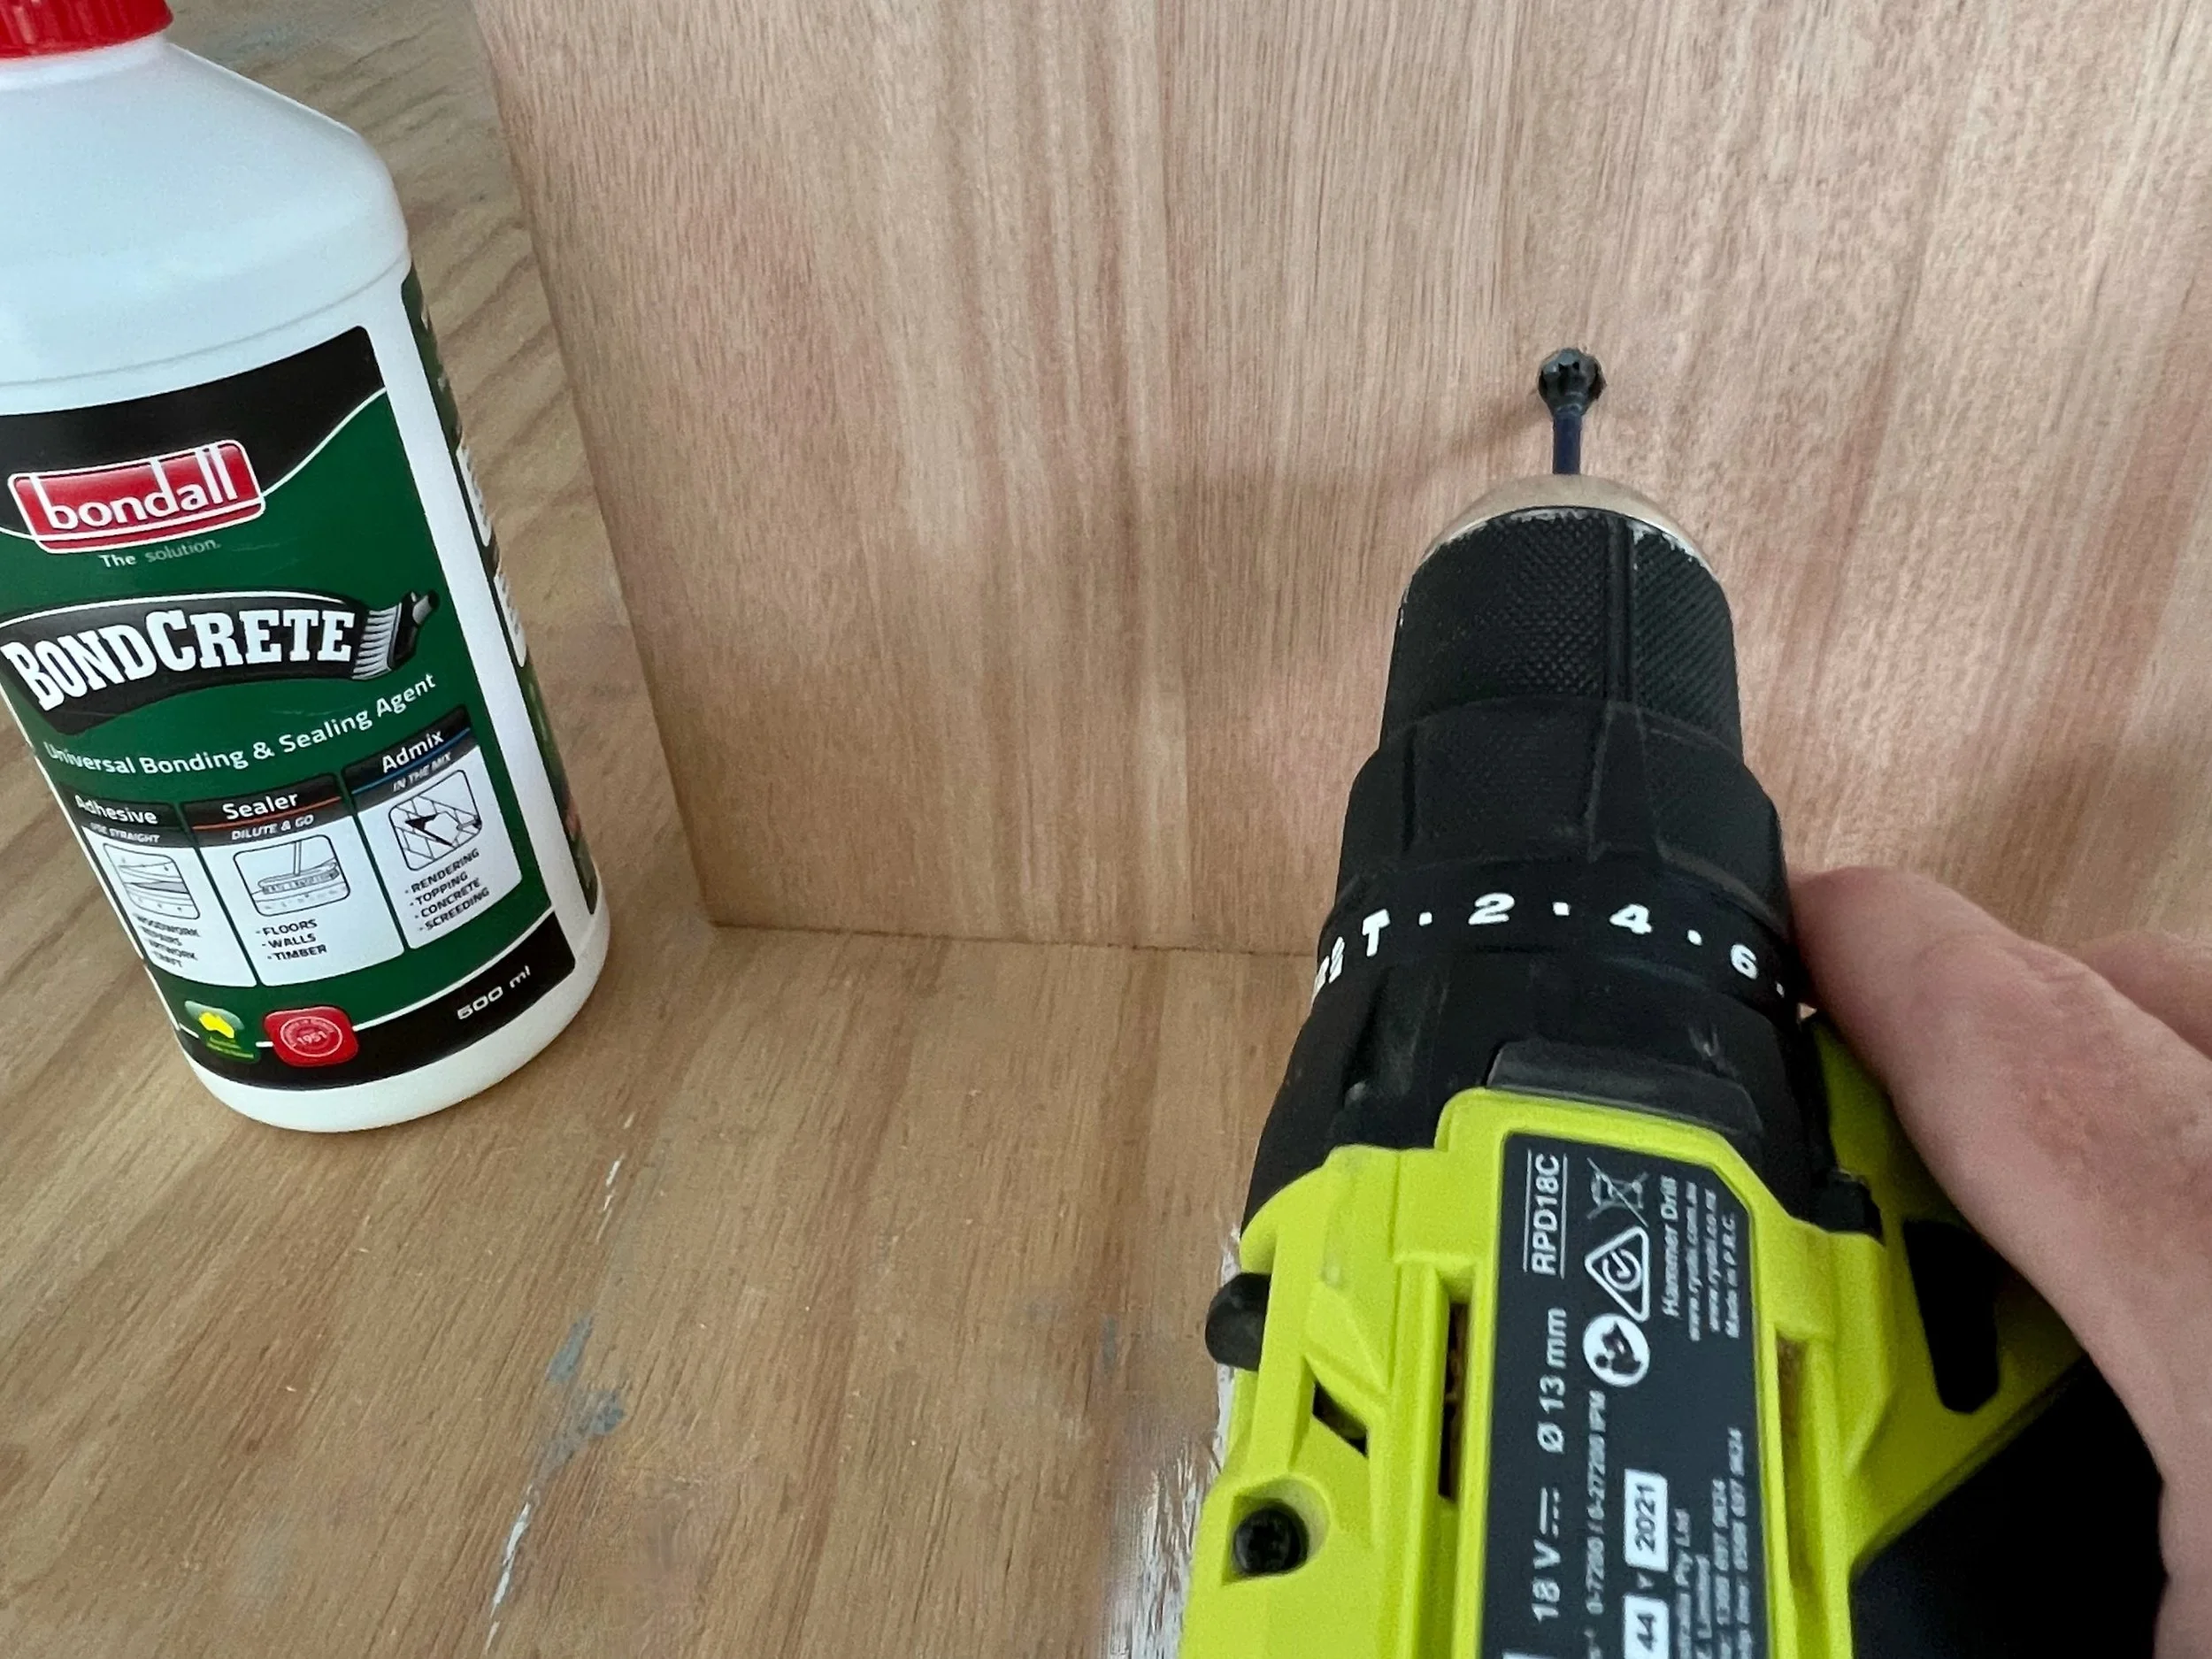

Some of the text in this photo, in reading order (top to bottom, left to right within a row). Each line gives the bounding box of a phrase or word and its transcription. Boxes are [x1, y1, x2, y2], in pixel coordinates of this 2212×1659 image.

[28, 444, 238, 530] bondall
[97, 553, 137, 569] The
[42, 673, 437, 776] Universal Bonding & Sealing Agent
[382, 731, 444, 773] Admix
[74, 794, 158, 825] Adhesive
[222, 794, 298, 820] Sealer
[231, 814, 314, 840] DILUTE & GO
[109, 827, 161, 843] STRAIGHT
[1469, 892, 1758, 979] 2 4 6
[457, 964, 531, 1019] 500 ml
[296, 1031, 327, 1045] 1951
[1531, 1152, 1560, 1276] RPD18C
[1547, 1308, 1567, 1369] mm
[1540, 1374, 1566, 1413] 13
[1635, 1483, 1656, 1554] 2021
[1533, 1539, 1561, 1570] V
[1532, 1576, 1561, 1623] 18
[1636, 1612, 1657, 1652] 44
